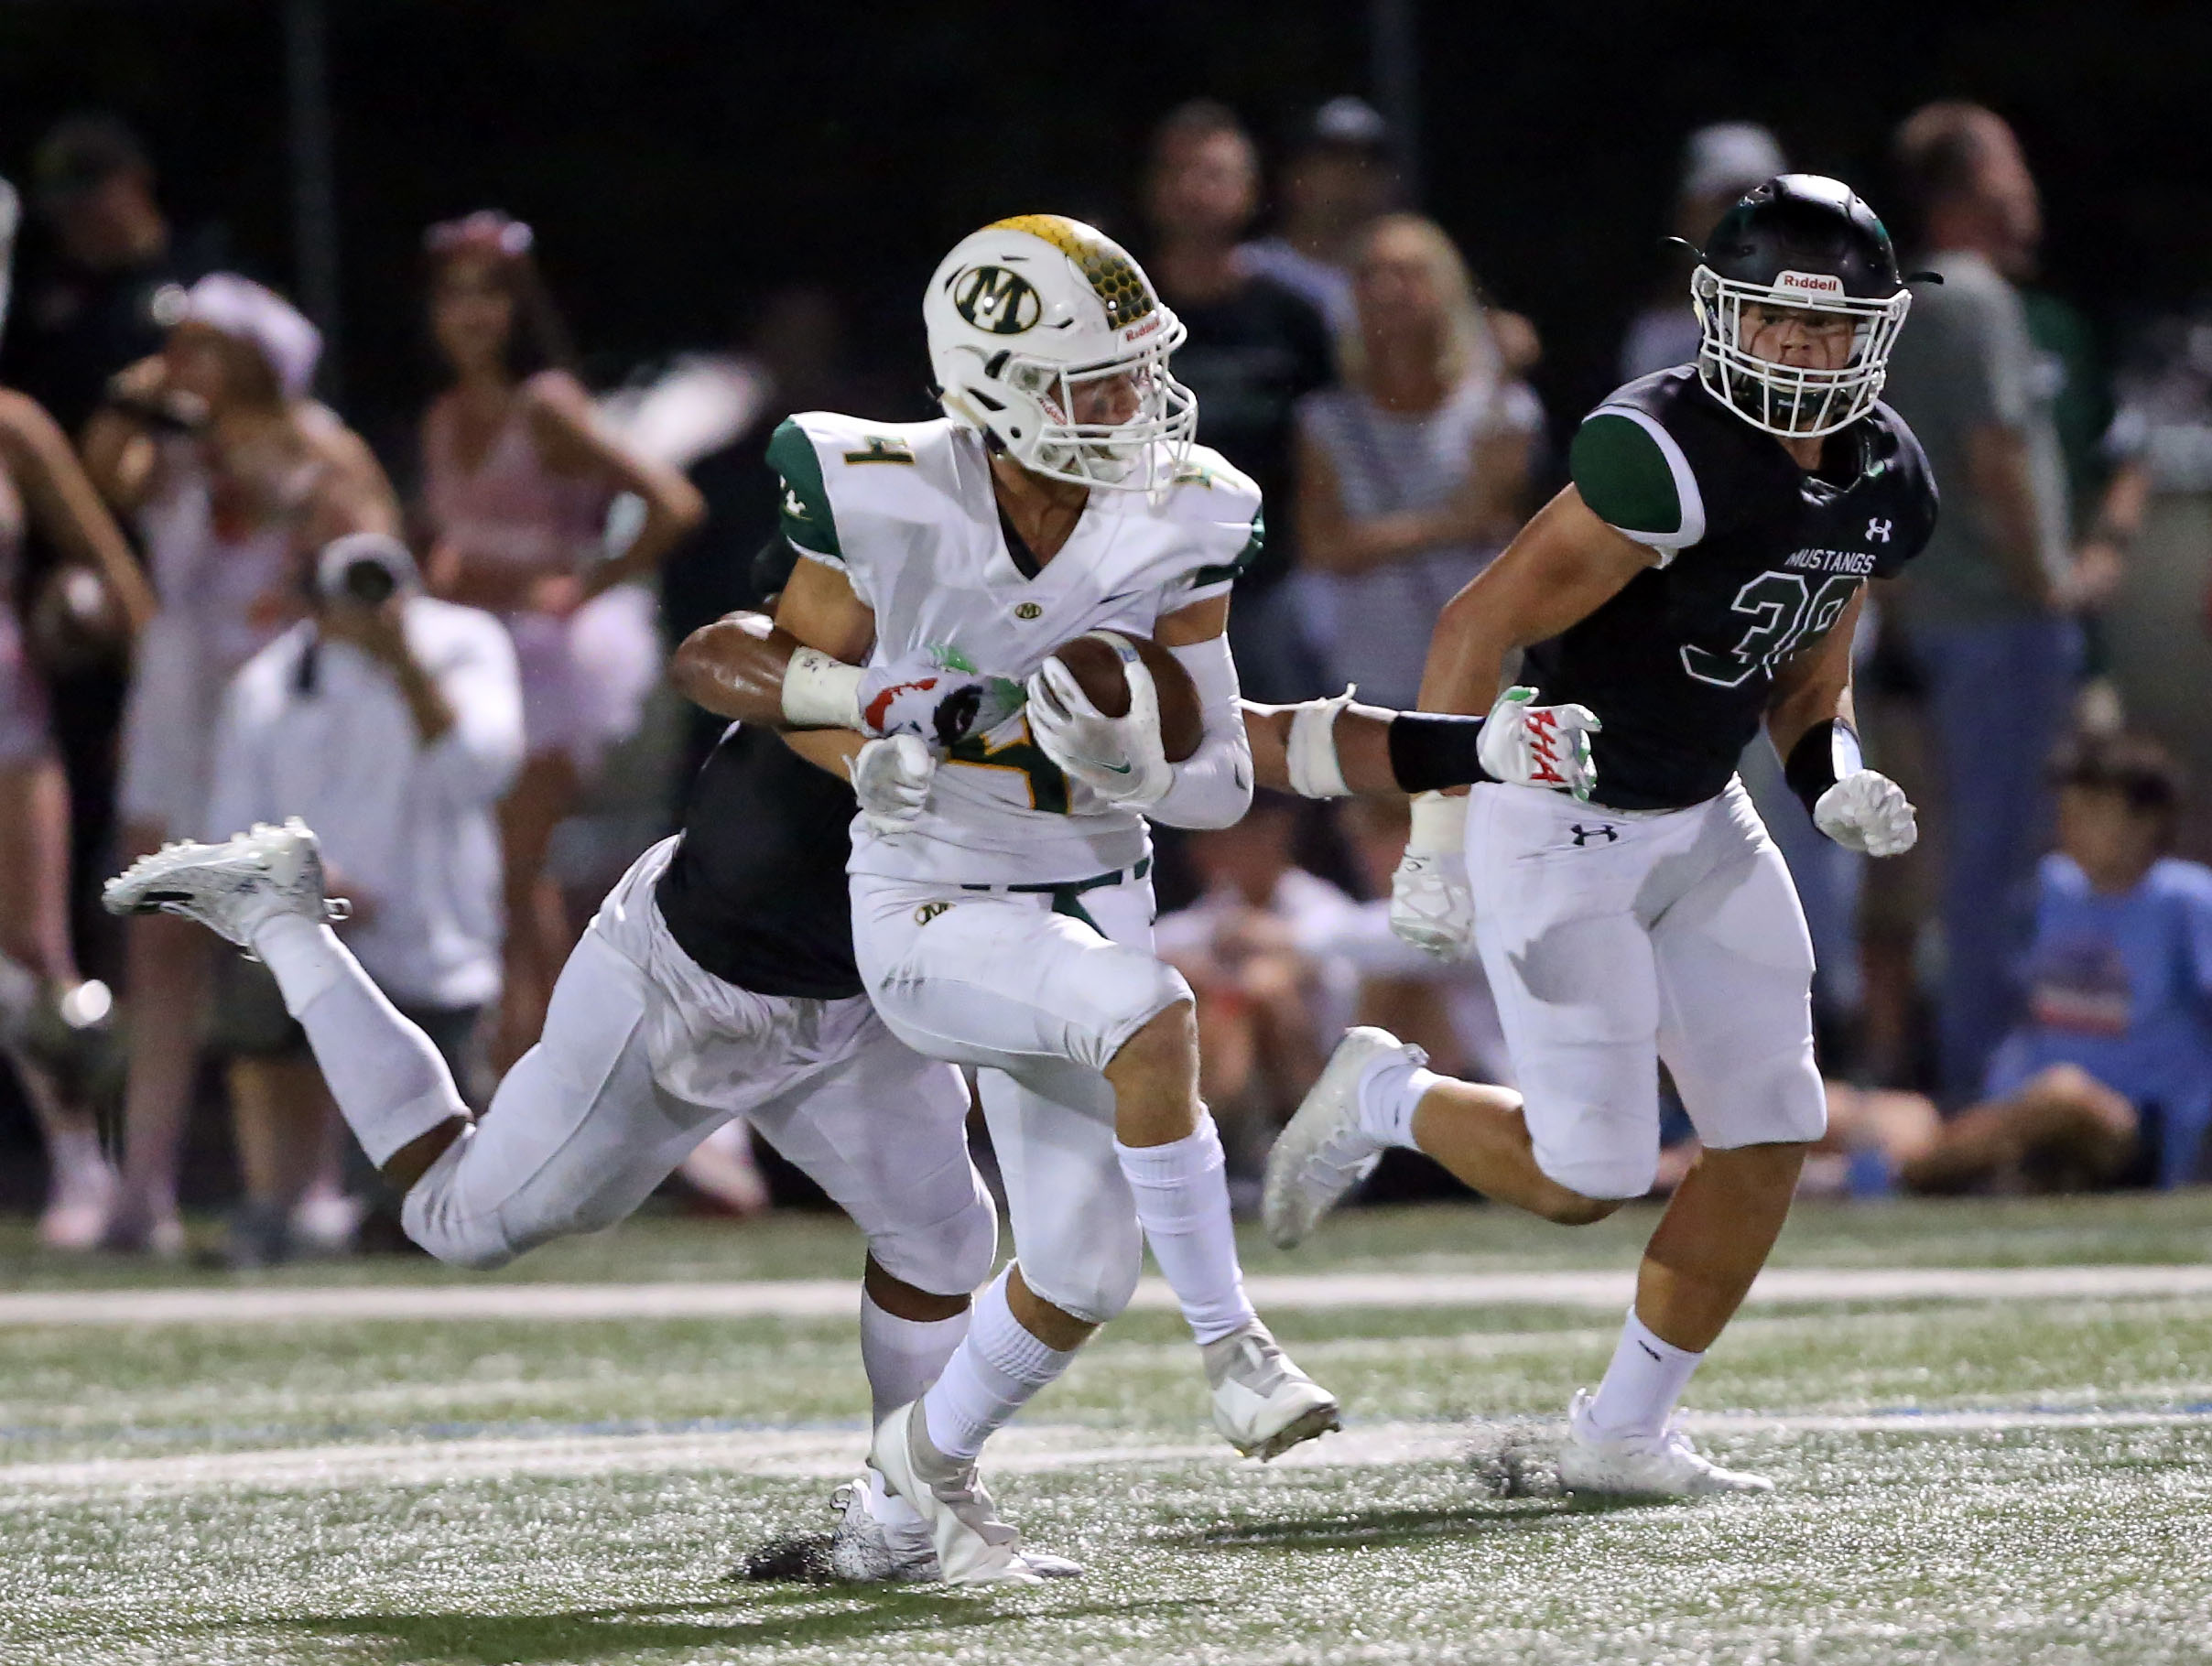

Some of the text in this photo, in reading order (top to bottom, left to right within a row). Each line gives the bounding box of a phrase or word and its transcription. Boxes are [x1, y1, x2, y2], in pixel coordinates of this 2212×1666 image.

[1783, 275, 1837, 291] Riddell
[957, 266, 1031, 333] M
[1784, 548, 1876, 574] MUSTANGS
